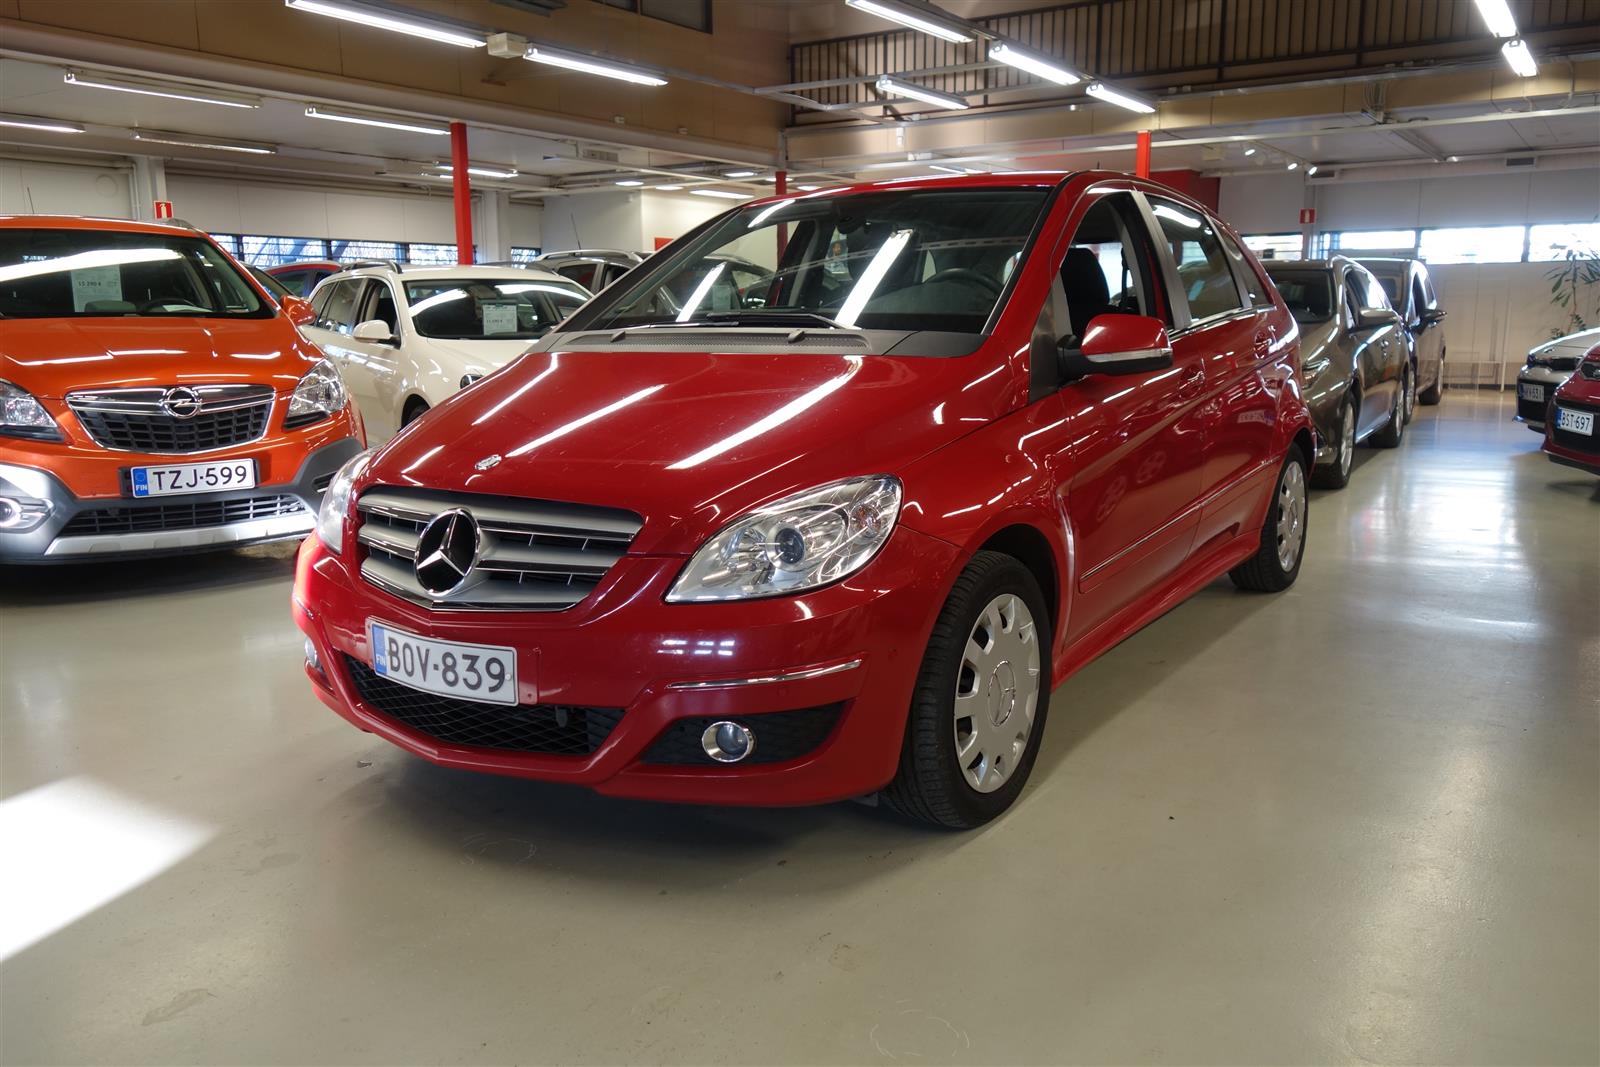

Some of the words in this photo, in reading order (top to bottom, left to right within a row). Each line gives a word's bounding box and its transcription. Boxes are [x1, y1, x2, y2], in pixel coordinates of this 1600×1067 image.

[1561, 412, 1591, 432] BST-697
[152, 465, 247, 491] TZJ-599
[375, 655, 386, 666] FIN
[387, 634, 506, 693] BOV-839
